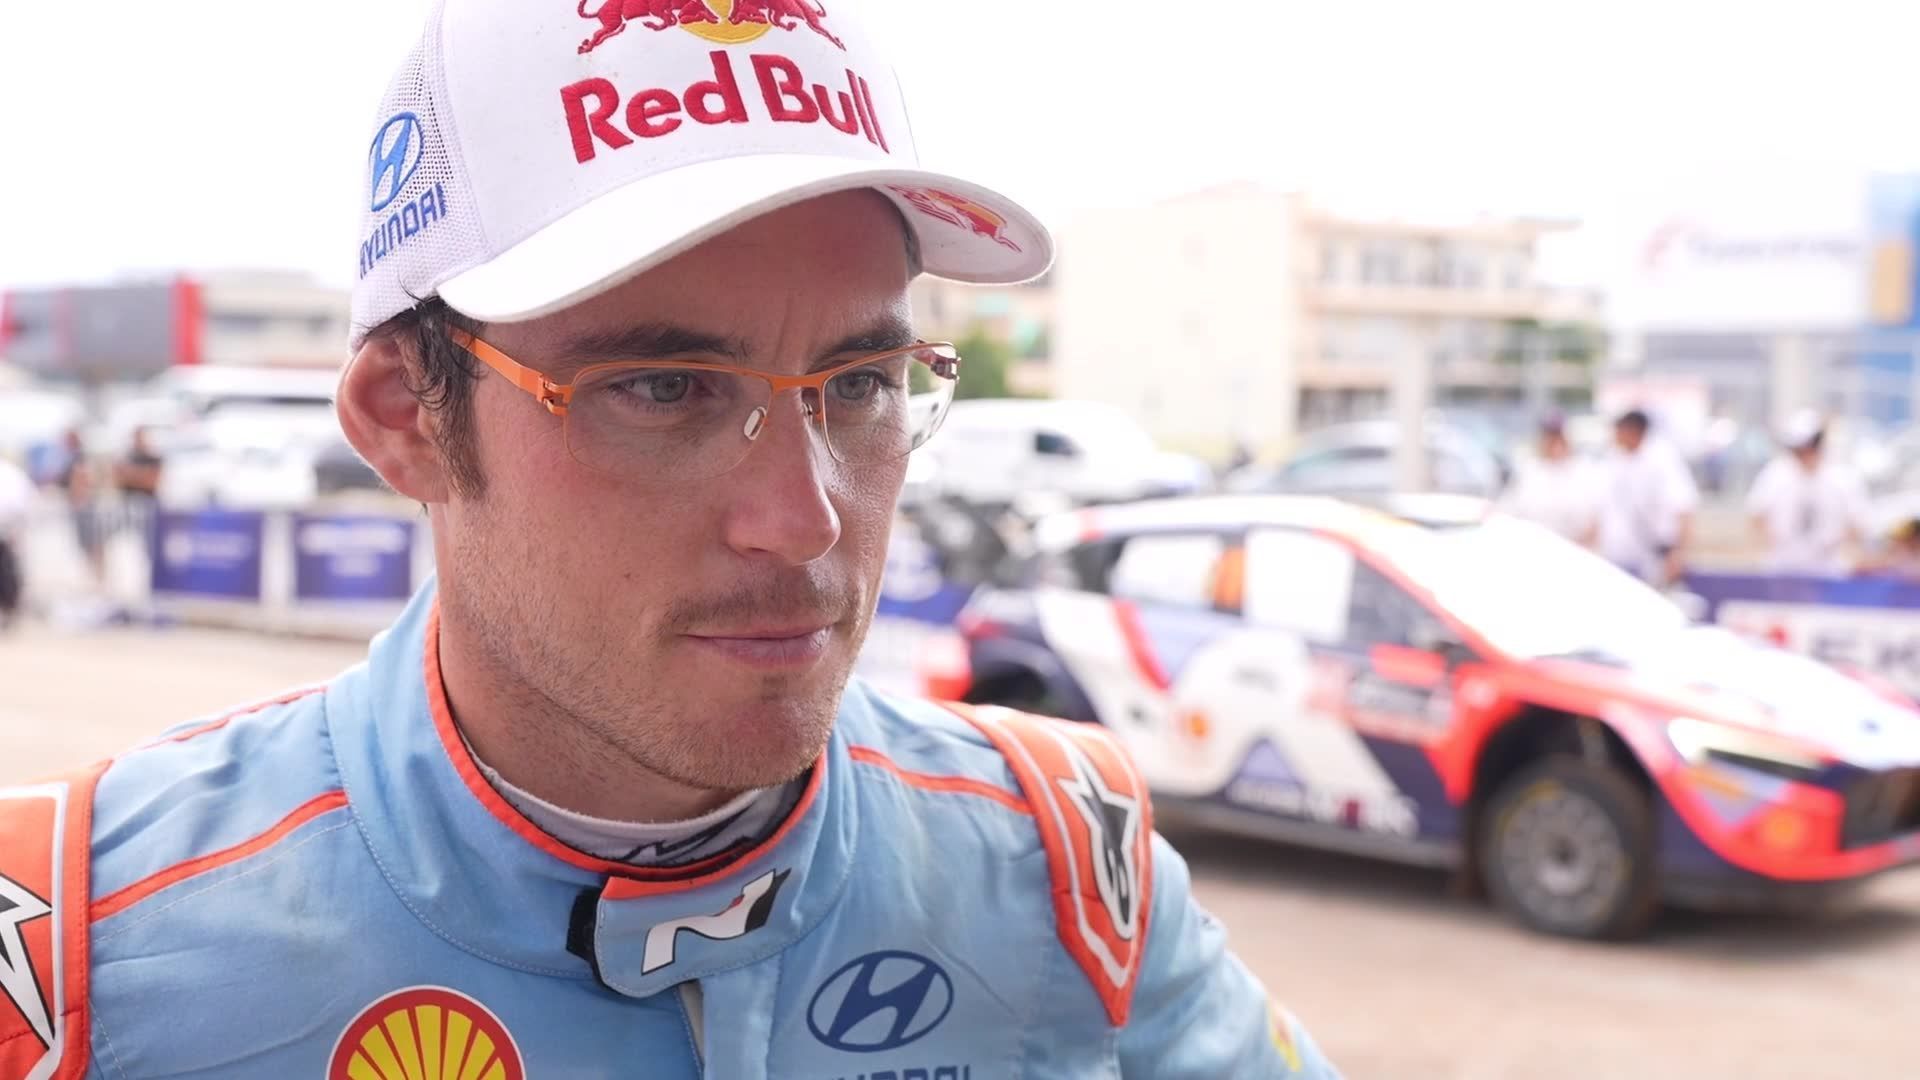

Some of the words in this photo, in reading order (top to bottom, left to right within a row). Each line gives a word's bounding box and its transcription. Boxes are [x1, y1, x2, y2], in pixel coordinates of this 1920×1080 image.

[560, 50, 749, 164] Red
[750, 54, 890, 154] Bull
[360, 182, 447, 280] HYUNDAI
